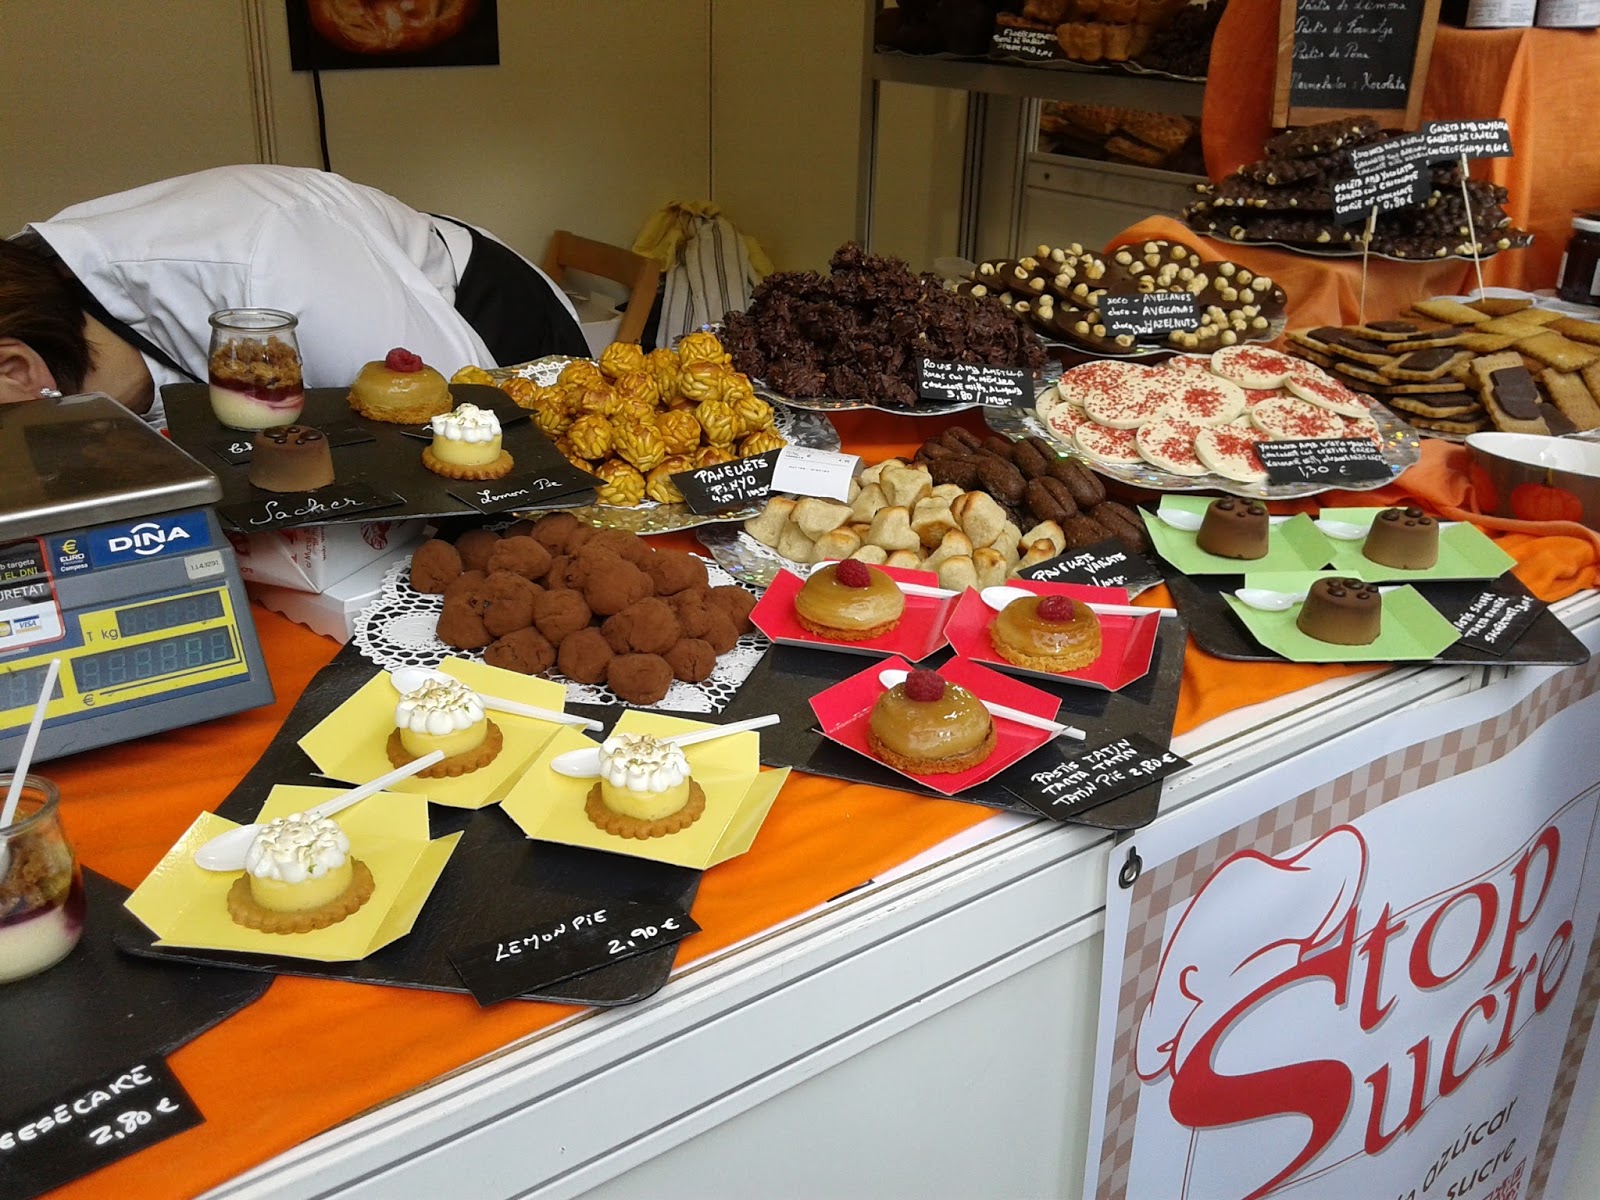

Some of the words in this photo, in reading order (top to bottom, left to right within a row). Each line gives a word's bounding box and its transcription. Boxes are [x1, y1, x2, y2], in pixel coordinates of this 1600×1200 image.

[1143, 293, 1191, 303] AVELLANES
[1144, 318, 1198, 330] HAZELNUTS
[1298, 465, 1329, 479] 1,30
[1339, 465, 1351, 476] €
[476, 489, 529, 504] Lemon
[250, 497, 364, 526] Sacher
[108, 526, 190, 552] DINA
[7, 557, 35, 571] targeta
[59, 553, 85, 563] EURO
[4, 571, 18, 581] EL
[19, 566, 39, 577] DNI
[19, 620, 37, 630] VISA
[101, 628, 119, 640] kg
[83, 694, 96, 706] €
[1082, 738, 1130, 763] TATIN
[1041, 770, 1090, 795] TARTA
[1052, 781, 1097, 806] TATIN
[1128, 758, 1162, 777] 2,80
[1162, 753, 1177, 764] €
[495, 923, 567, 962] LEMON
[572, 909, 608, 931] PIE
[607, 925, 658, 955] 2,90
[660, 917, 681, 931] €
[89, 1110, 152, 1146] 2,80
[156, 1097, 180, 1113] €
[1422, 1096, 1518, 1193] azúcar
[1447, 1138, 1516, 1200] sucre
